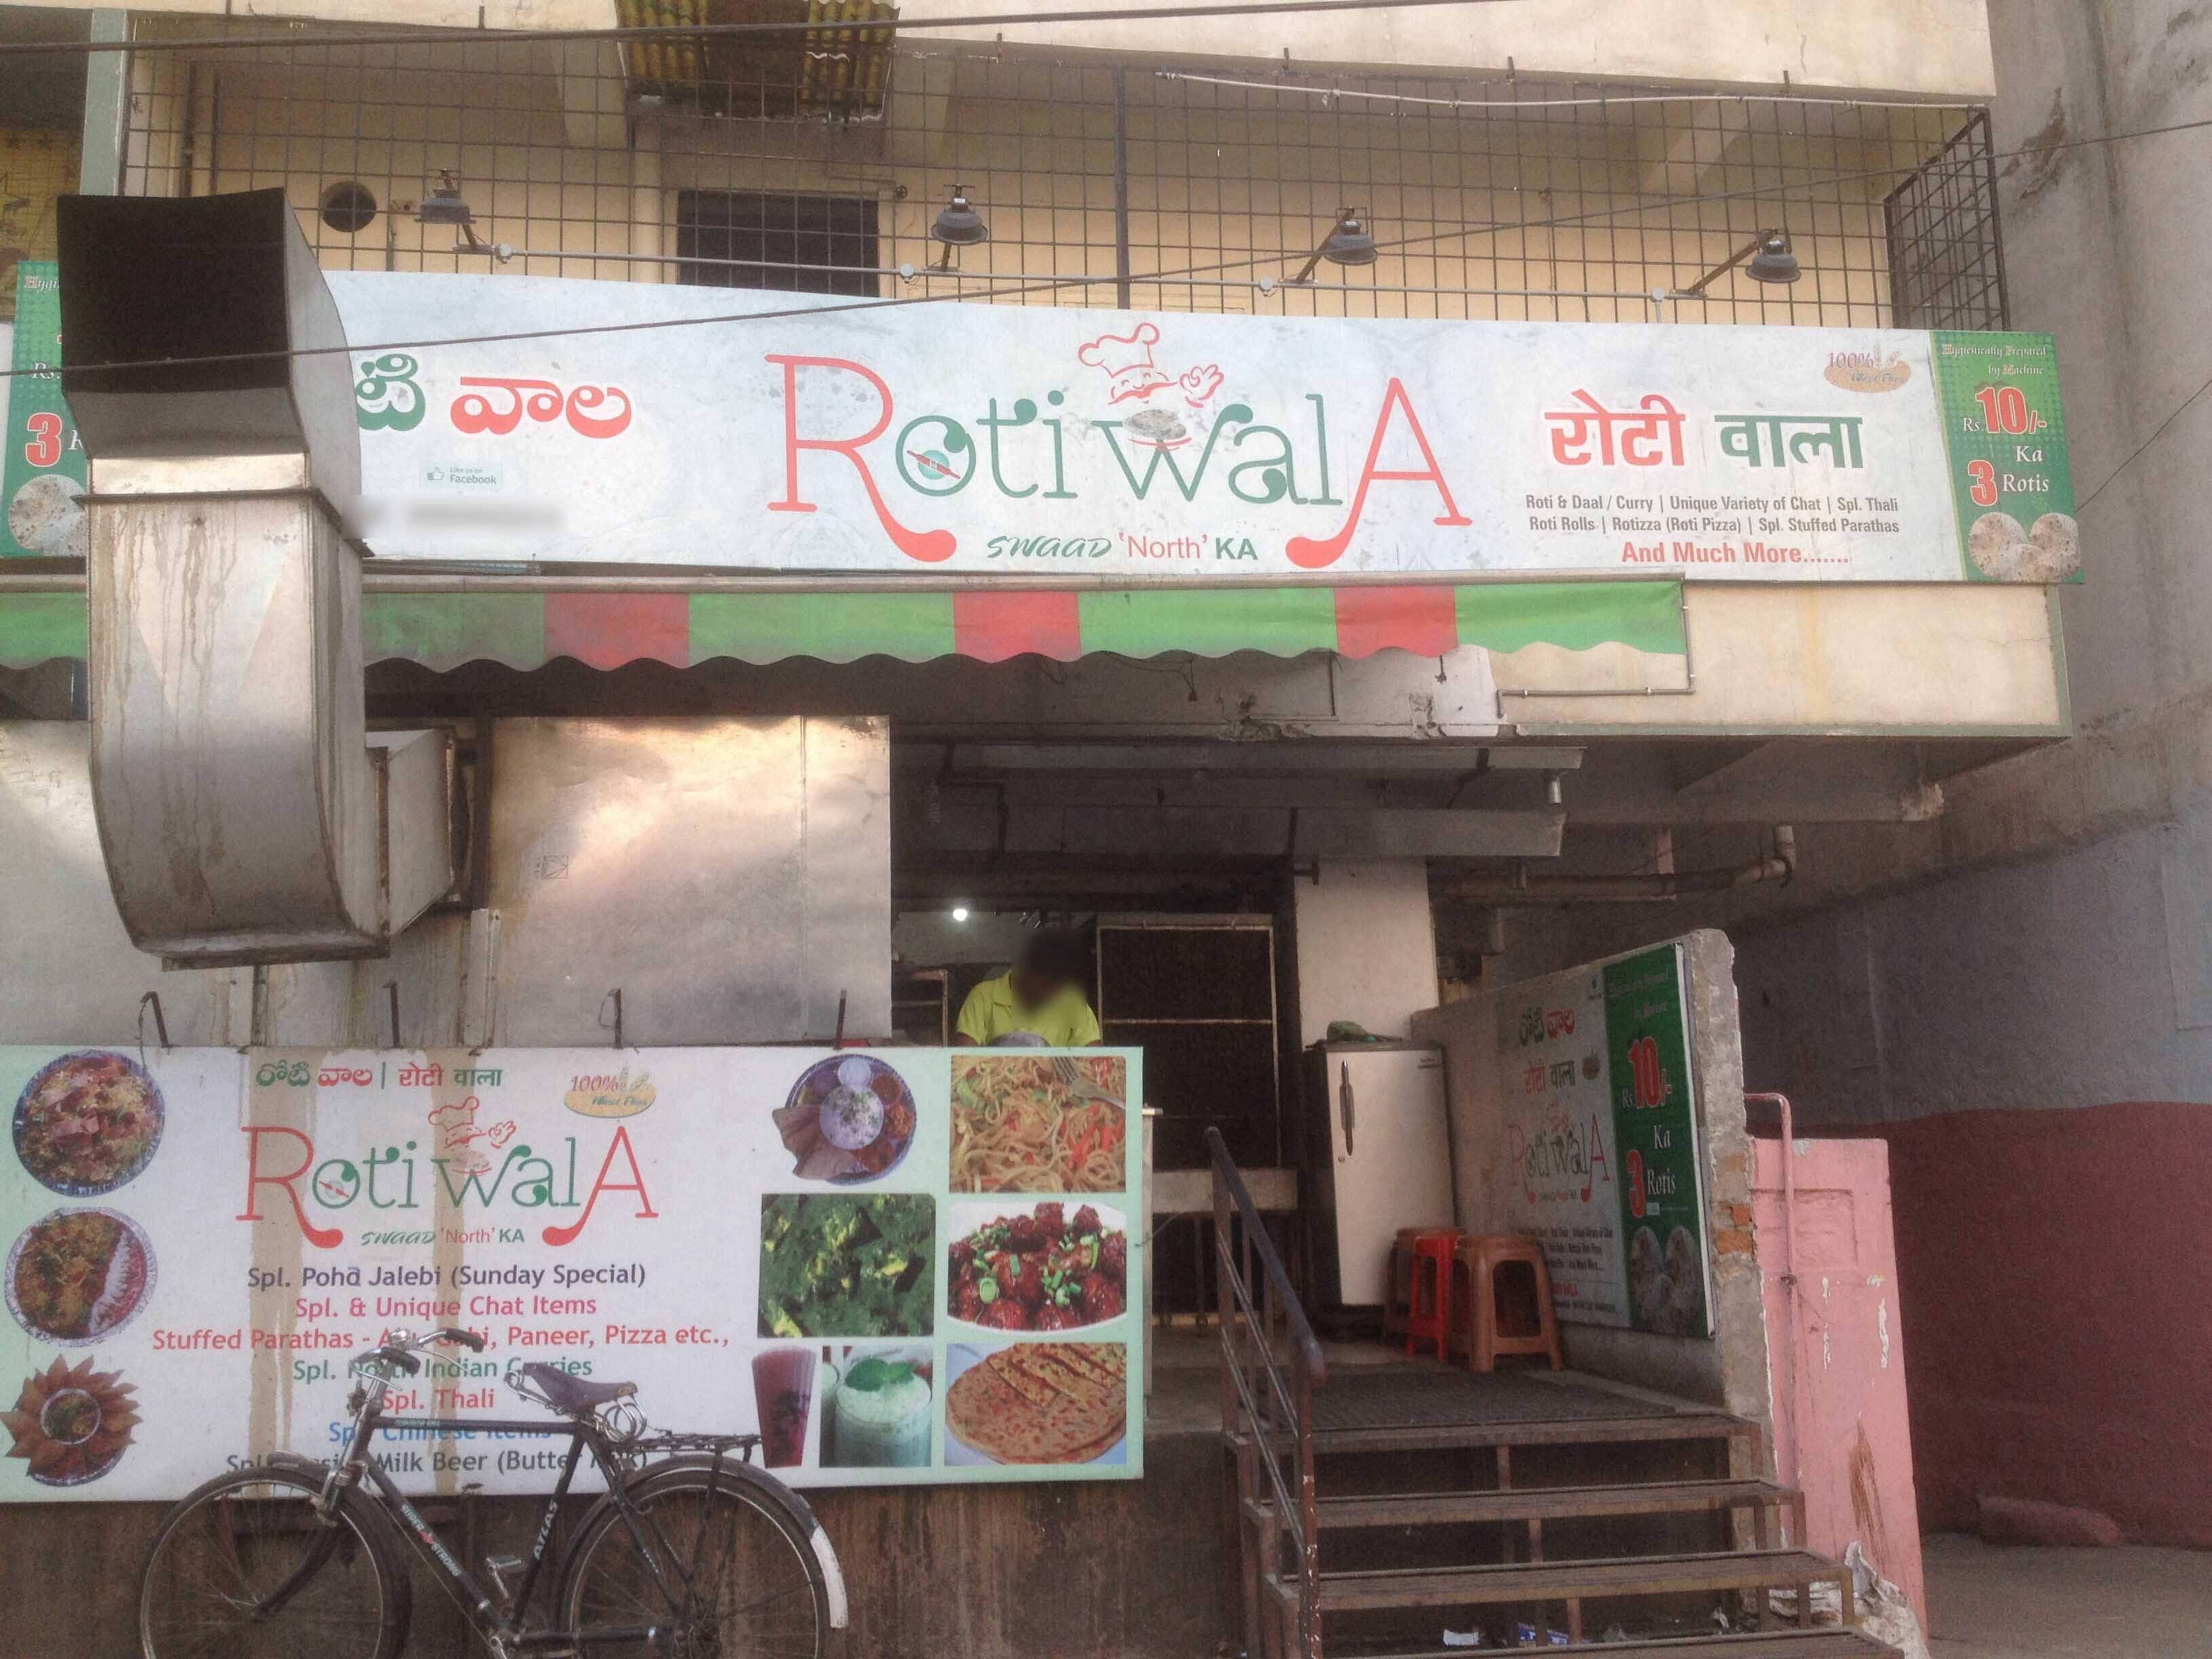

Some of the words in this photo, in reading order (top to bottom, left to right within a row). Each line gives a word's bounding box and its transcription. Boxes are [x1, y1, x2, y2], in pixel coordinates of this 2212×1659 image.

[1827, 351, 1874, 369] 100%
[1941, 343, 2003, 359] Hygienically
[2005, 344, 2047, 358] Prepared
[1988, 364, 2000, 378] by
[2002, 364, 2044, 375] Machine
[451, 376, 632, 439] వాల
[1975, 386, 2047, 435] 10/-
[25, 412, 62, 467] 3
[1544, 389, 1686, 466] रोटी
[1715, 414, 1863, 468] वाला
[2015, 445, 2043, 463] Ka
[449, 474, 497, 485] Facebook
[1967, 459, 1999, 506] 3
[2003, 474, 2049, 492] Rotis
[1525, 495, 1553, 510] Roti
[1558, 495, 1567, 509] &
[1572, 495, 1603, 510] Daal
[1616, 495, 1653, 512] Curry
[1670, 495, 1717, 513] Unique
[1721, 496, 1768, 513] Variety
[1773, 496, 1786, 510] of
[1790, 497, 1821, 510] Chat
[1837, 497, 1862, 514] Spl.
[1865, 497, 1898, 511] Thali
[1530, 517, 1557, 531] Roti
[1561, 517, 1595, 531] Rolls
[1612, 517, 1661, 531] Rotizza
[1666, 517, 1698, 533] (Roti
[1702, 518, 1741, 534] Pizza)
[1759, 518, 1783, 534] Spl.
[1788, 518, 1837, 532] Stuffed
[1841, 519, 1900, 533] Parathas
[1215, 537, 1258, 560] KA
[1622, 541, 1665, 562] And
[1673, 541, 1736, 563] Much
[317, 1067, 373, 1087] వాల
[398, 1062, 445, 1087] रोटी
[454, 1068, 503, 1086] वाला
[571, 1074, 619, 1092] 100%
[1654, 1125, 1671, 1150] Ka
[1626, 1150, 1646, 1218] 3
[1647, 1168, 1676, 1196] Rotis
[499, 1229, 525, 1243] KA
[247, 1267, 291, 1292] Spl.
[369, 1265, 441, 1286] Jalebi
[451, 1265, 545, 1289] (Sunday
[553, 1263, 645, 1288] Special)
[295, 1297, 338, 1322] Spl.
[349, 1297, 367, 1317] &
[376, 1296, 461, 1320] Unique
[469, 1296, 524, 1316] Chat
[533, 1295, 597, 1314] Items
[153, 1329, 241, 1349] Stuffed
[251, 1328, 353, 1349] Parathas
[508, 1326, 595, 1348] Paneer,
[605, 1325, 666, 1344] Pizza
[675, 1325, 728, 1347] etc.,
[293, 1359, 337, 1383] Spl.
[425, 1357, 497, 1378] Indian
[383, 1391, 424, 1414] Spl.
[436, 1388, 494, 1409] Thali
[433, 1452, 488, 1471] Beer
[533, 1498, 558, 1562] ATLAS
